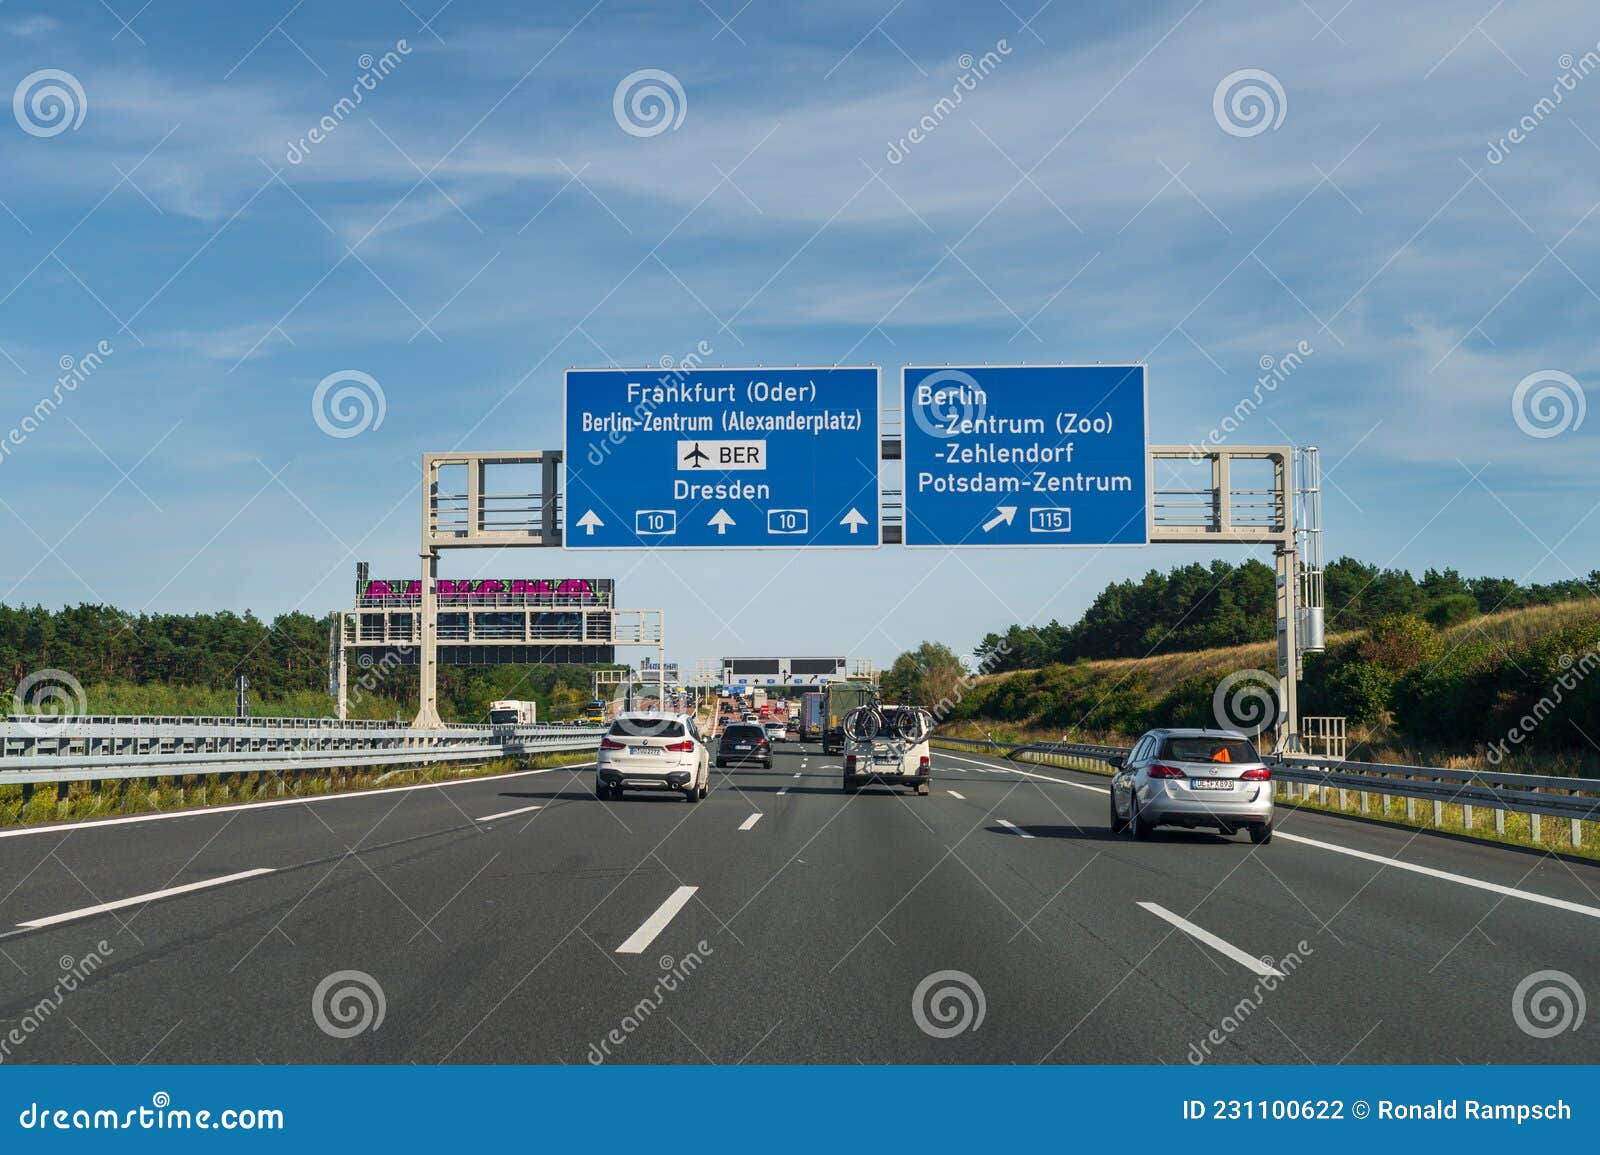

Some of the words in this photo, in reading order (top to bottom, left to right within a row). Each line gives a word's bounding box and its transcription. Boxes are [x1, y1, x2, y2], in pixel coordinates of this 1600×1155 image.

[627, 383, 735, 402] Frankfurt
[746, 381, 816, 402] (Oder)
[918, 386, 987, 406] Berlin
[582, 411, 713, 432] Berlin-Zentrum
[721, 409, 862, 435] (Alexanderplatz)
[935, 414, 1044, 434] -Zentrum
[1056, 412, 1113, 434] (Zoo)
[719, 447, 759, 463] BER
[935, 442, 1074, 463] -Zehlendorf
[674, 479, 770, 500] Dresden
[918, 472, 1132, 492] Potsdam-Zentrum
[648, 515, 664, 530] 10
[779, 514, 796, 529] 10
[1039, 512, 1063, 528] 115
